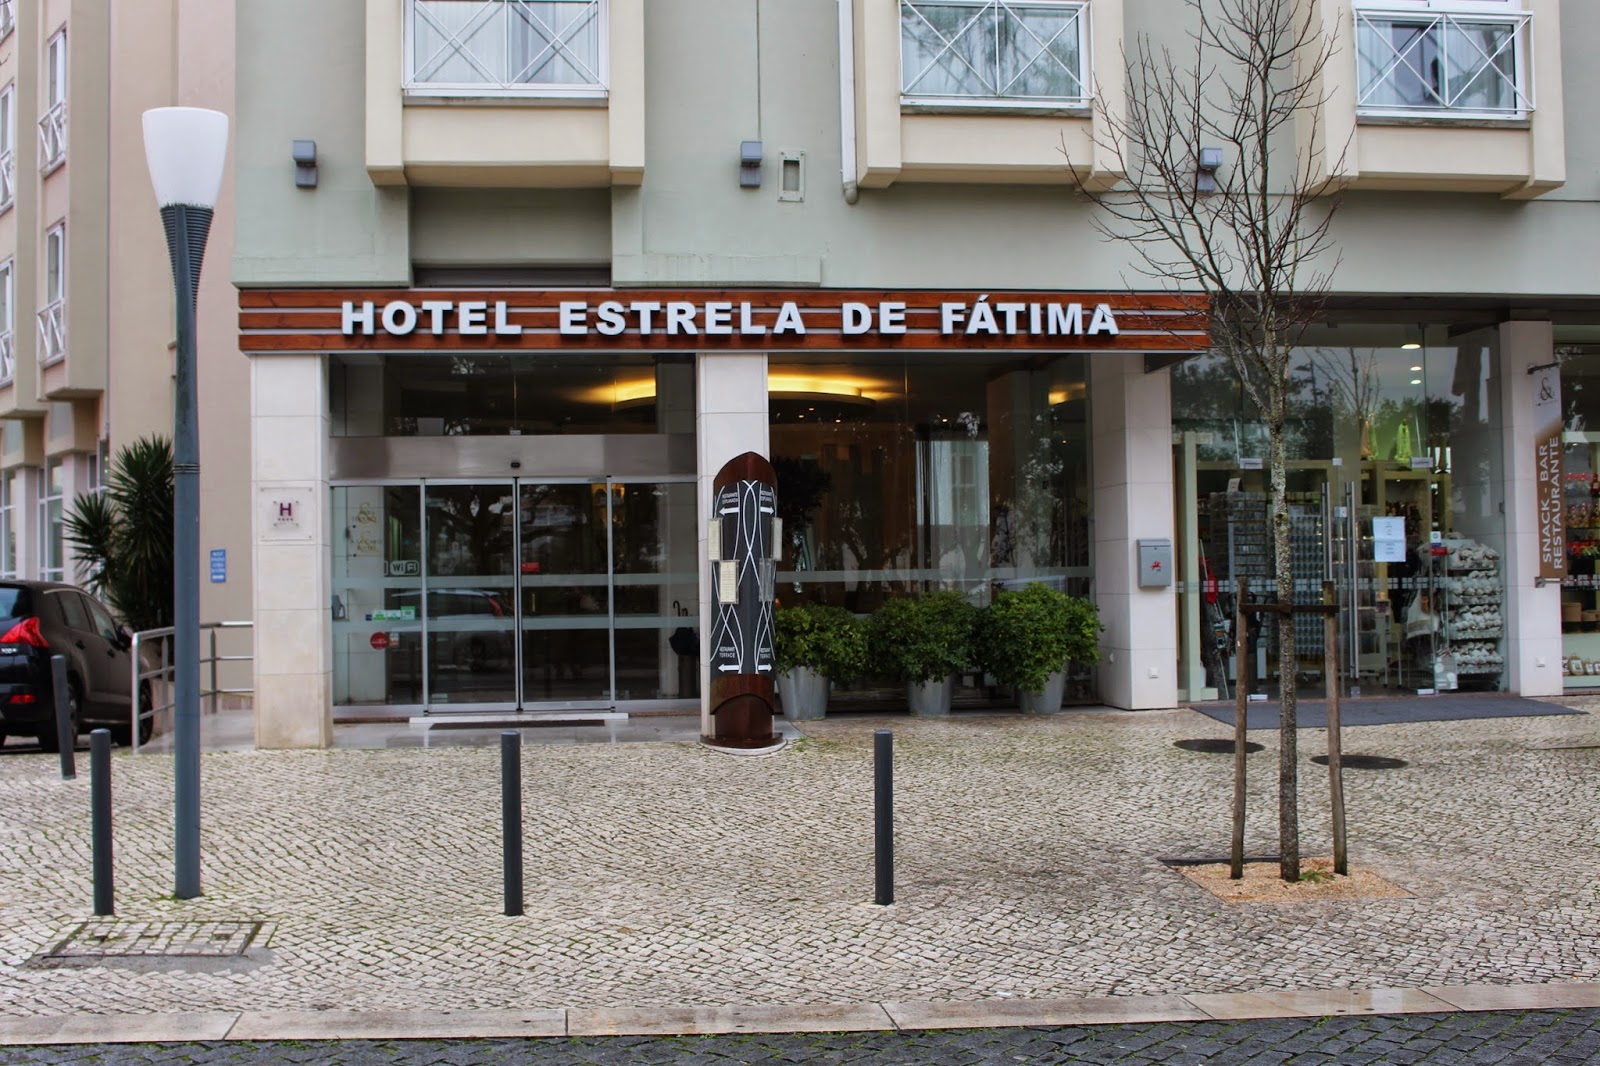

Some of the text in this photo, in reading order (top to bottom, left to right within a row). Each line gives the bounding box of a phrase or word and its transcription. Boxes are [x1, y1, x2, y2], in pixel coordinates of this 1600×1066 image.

[342, 294, 1120, 335] HOTEL ESTRELA DE FÁTIMA
[1540, 444, 1549, 482] BAR
[279, 502, 292, 517] H
[1550, 436, 1563, 569] RESTAURANTE
[1542, 498, 1552, 563] SNACK
